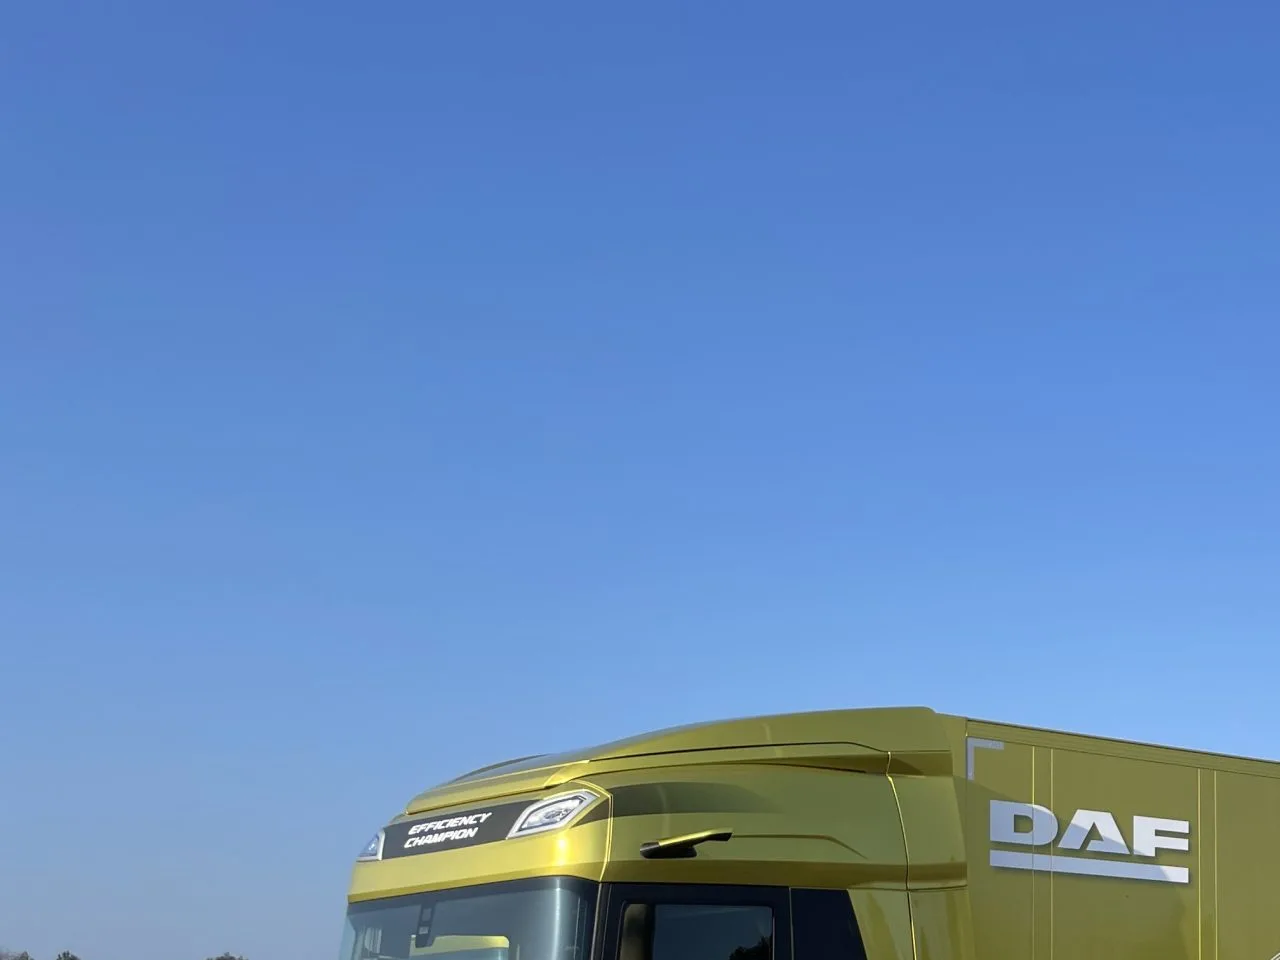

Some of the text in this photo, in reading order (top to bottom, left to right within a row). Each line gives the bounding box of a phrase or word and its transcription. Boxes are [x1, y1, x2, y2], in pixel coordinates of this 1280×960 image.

[408, 812, 492, 835] EFFICIENCY
[990, 800, 1189, 857] DAF
[404, 827, 478, 848] CHAMPION
